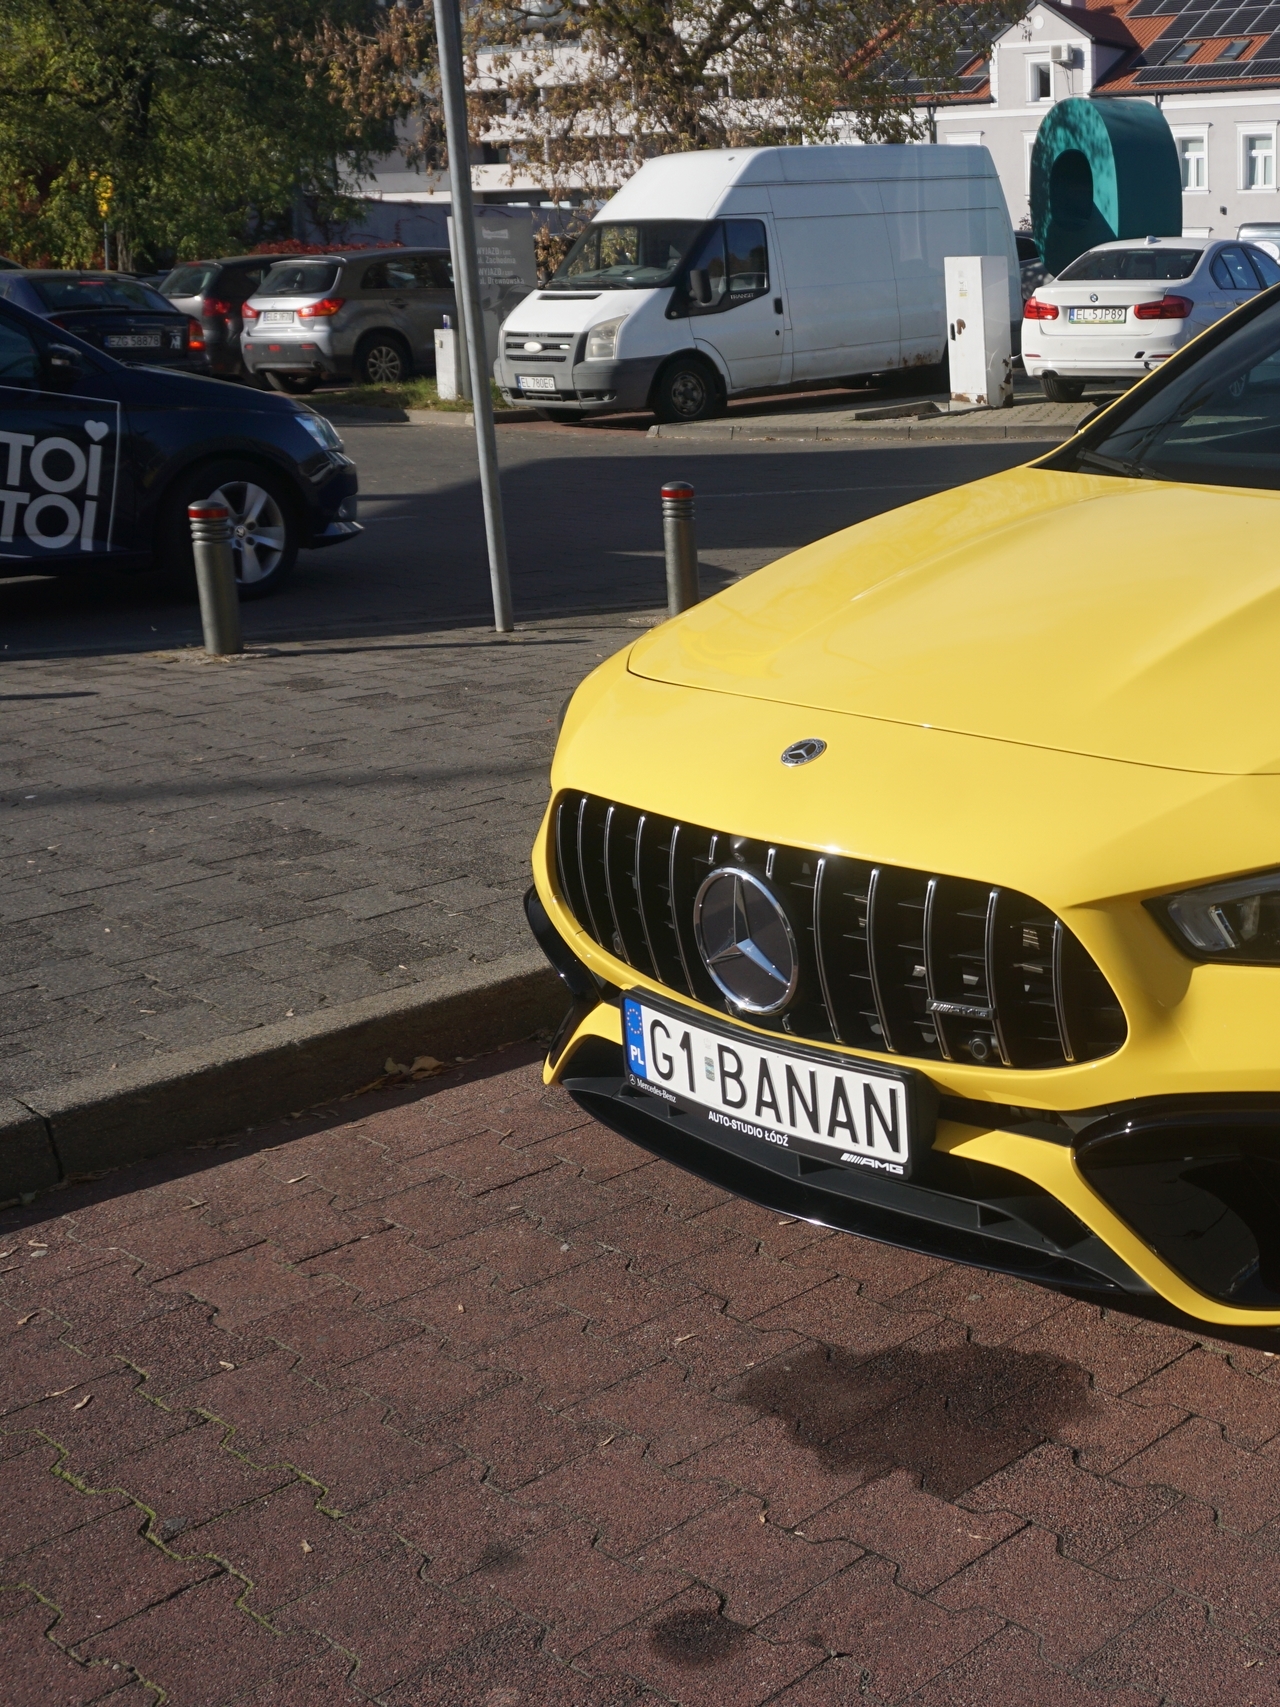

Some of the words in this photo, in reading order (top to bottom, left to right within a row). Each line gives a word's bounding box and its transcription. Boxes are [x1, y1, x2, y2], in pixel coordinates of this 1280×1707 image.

[485, 256, 516, 264] Zachodnia
[487, 277, 525, 285] Drewnowska
[1076, 309, 1088, 320] EL
[1092, 308, 1123, 320] 5JP89
[520, 377, 531, 388] EL
[630, 1044, 645, 1066] PL
[636, 1077, 677, 1104] Mercedes-Benz
[649, 1018, 697, 1094] G1
[717, 1043, 902, 1154] BANAN
[708, 1110, 763, 1139] AUTO-STUDIO
[764, 1129, 789, 1147] ŁÓDŹ
[859, 1158, 904, 1176] AMG
